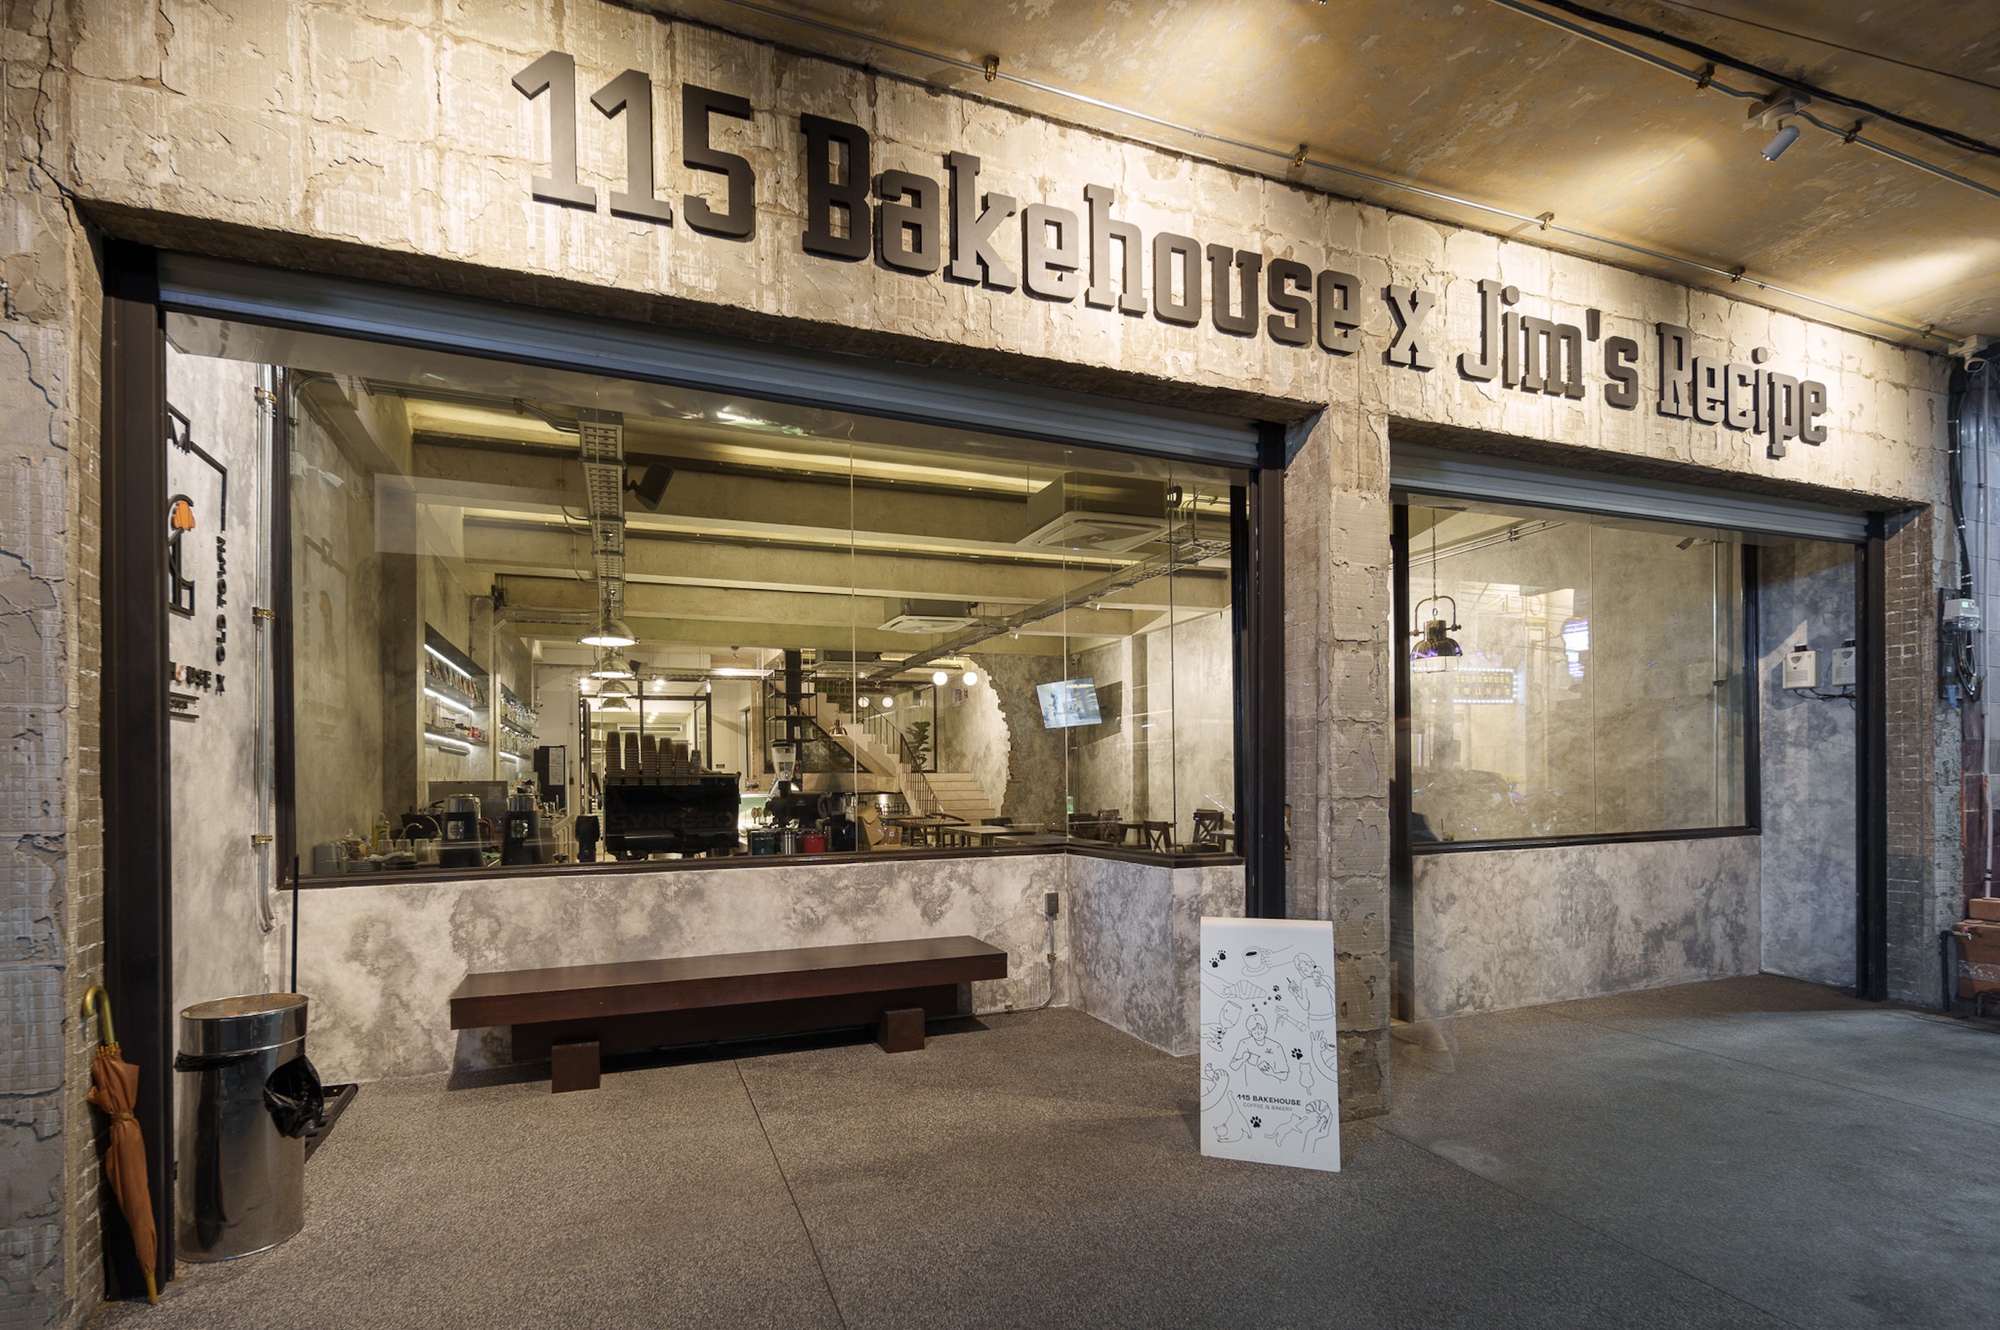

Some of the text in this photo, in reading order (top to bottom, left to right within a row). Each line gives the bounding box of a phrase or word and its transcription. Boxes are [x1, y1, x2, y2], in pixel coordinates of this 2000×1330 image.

[511, 50, 1828, 458] 115 Bakehouse x Jim's Recipe
[1253, 1095, 1301, 1106] BAKEHOUSE
